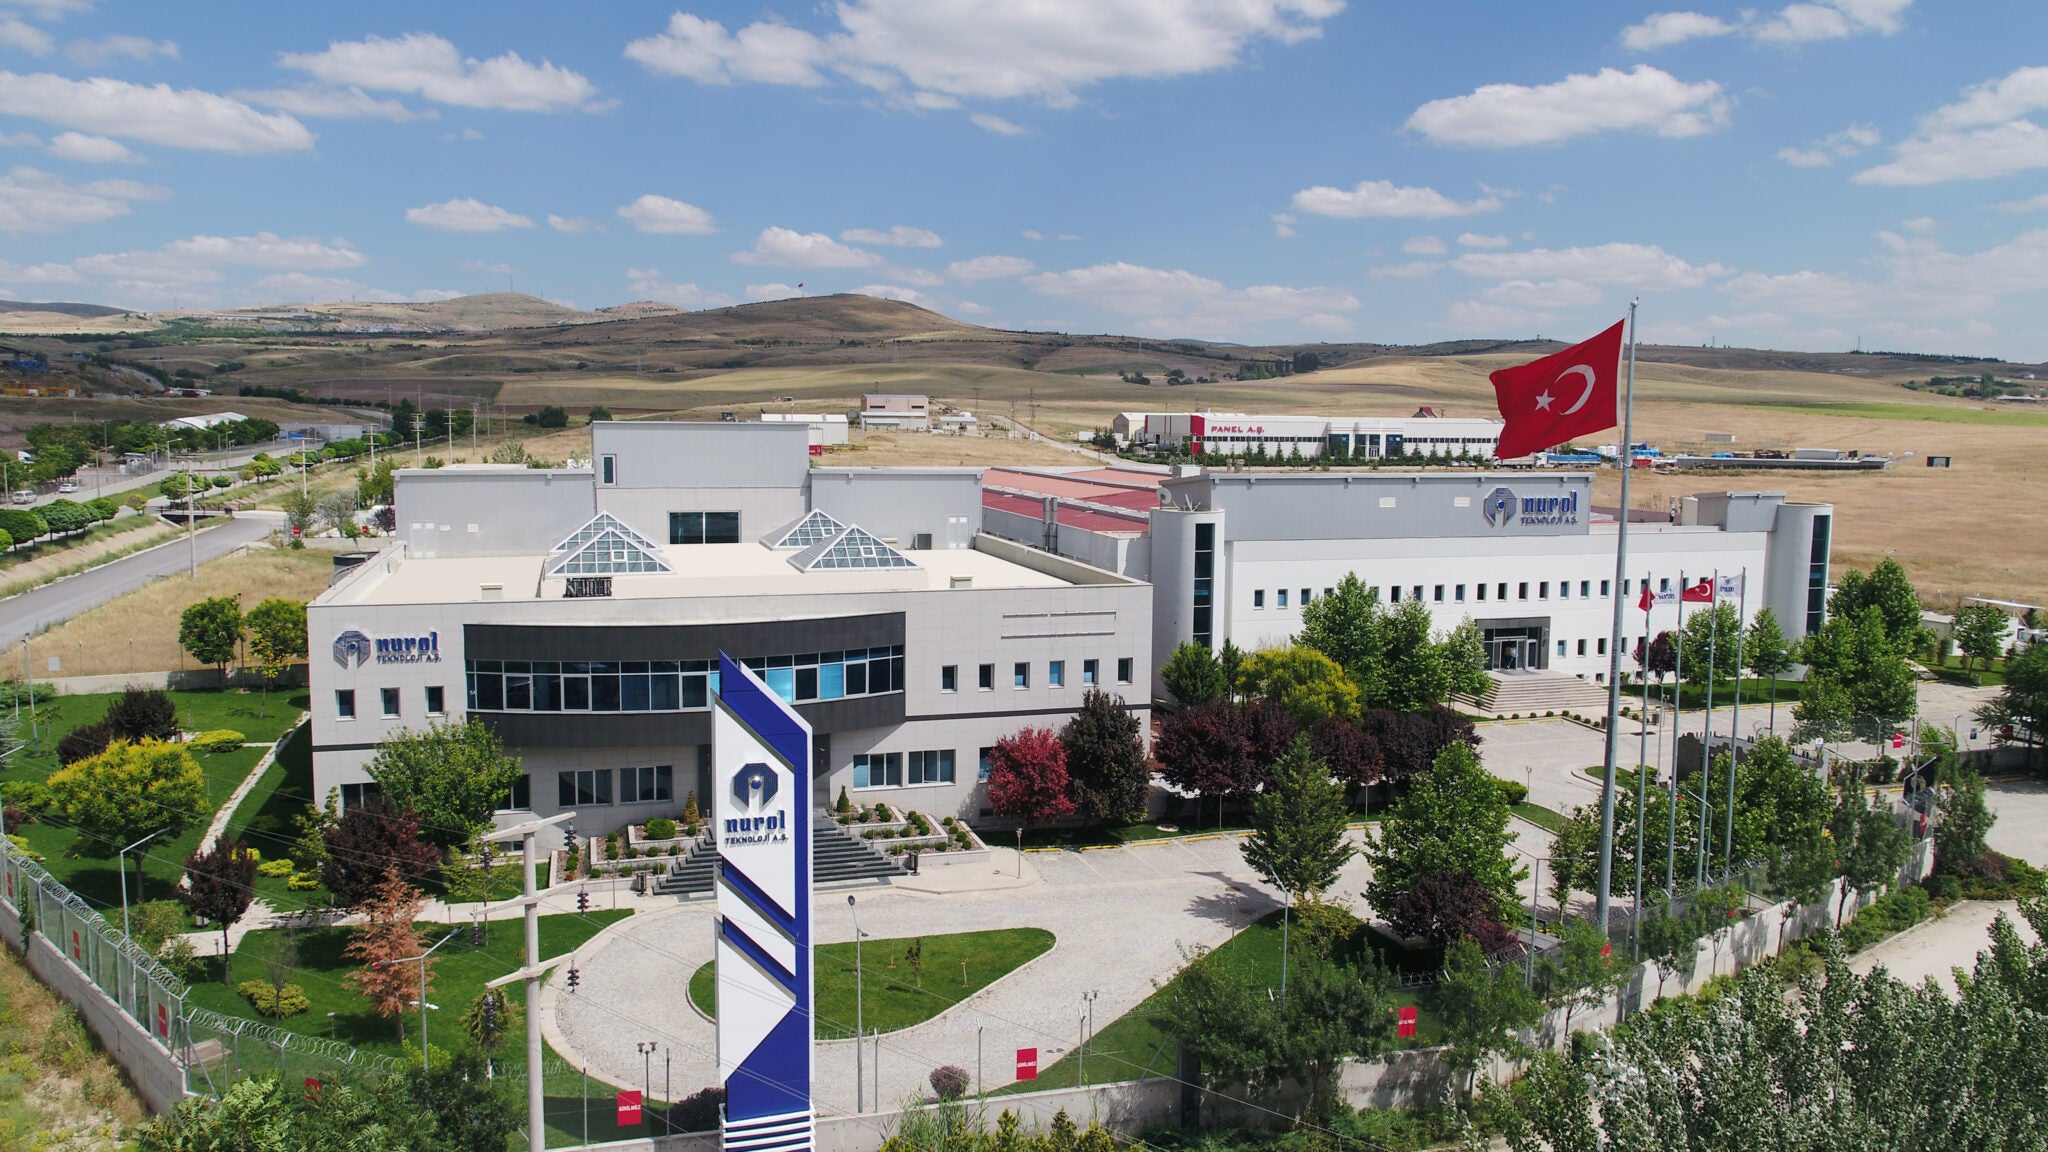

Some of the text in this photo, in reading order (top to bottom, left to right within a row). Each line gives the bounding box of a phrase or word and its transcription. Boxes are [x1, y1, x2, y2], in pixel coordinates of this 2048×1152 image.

[1211, 426, 1244, 434] PANEL
[1522, 490, 1578, 514] nurol
[376, 631, 439, 654] nurol
[725, 809, 786, 833] nurol
